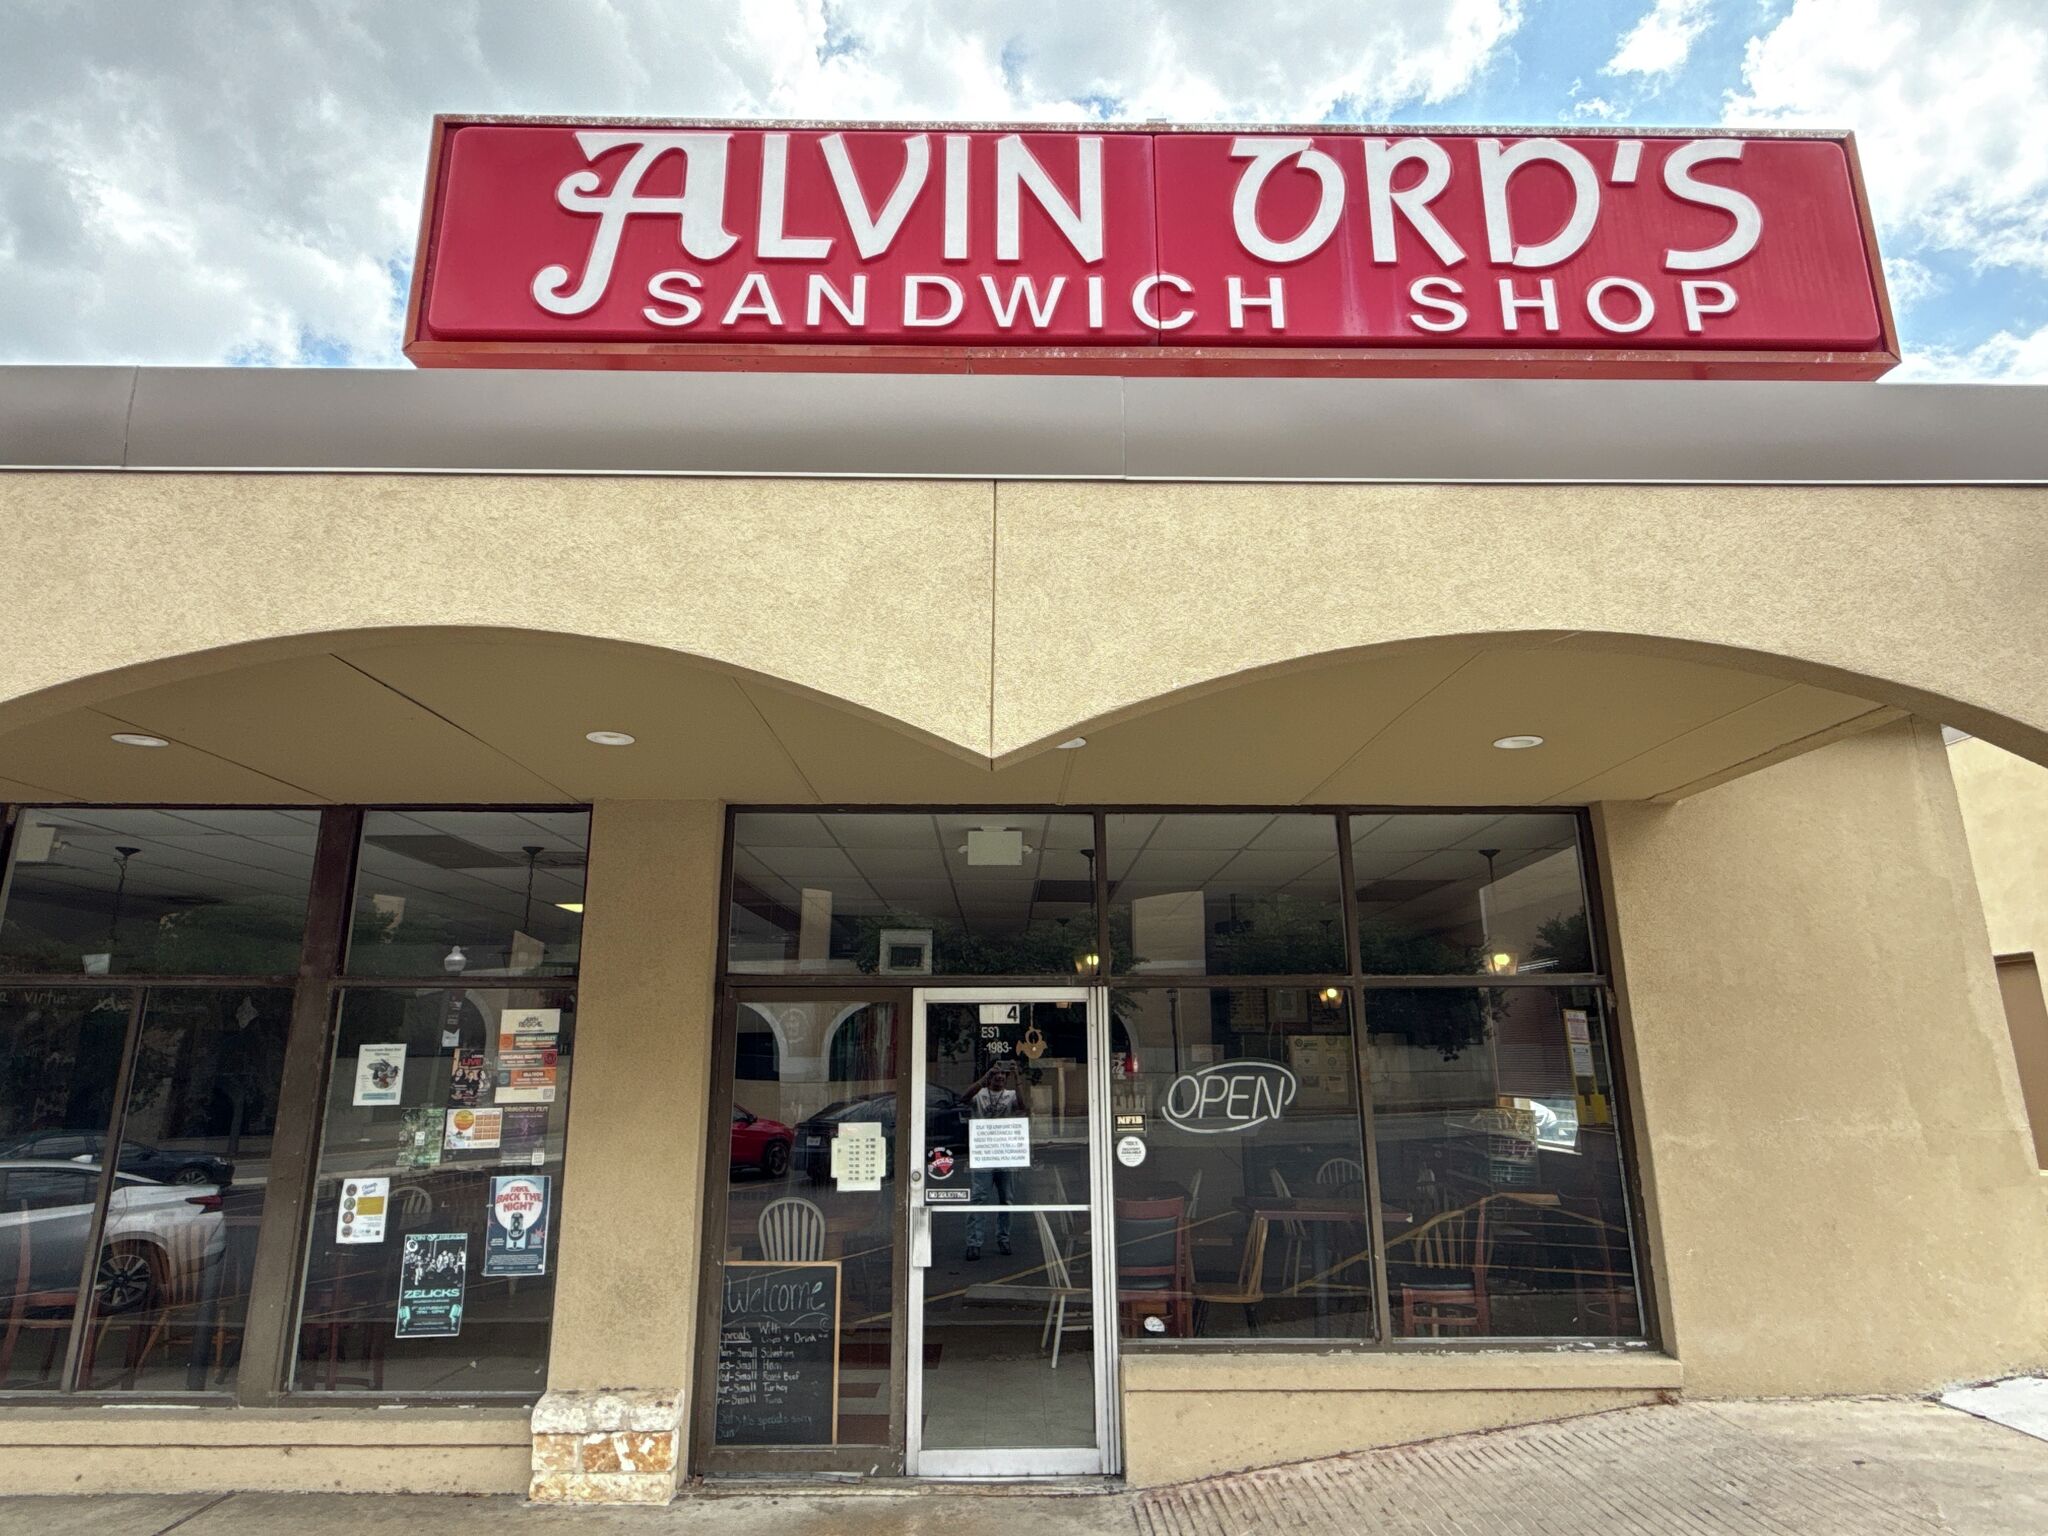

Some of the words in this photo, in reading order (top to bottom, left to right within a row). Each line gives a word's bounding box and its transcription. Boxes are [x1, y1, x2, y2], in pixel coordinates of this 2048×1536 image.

[532, 132, 1105, 315] ALVIN
[1229, 137, 1764, 272] ORD'S
[642, 271, 1287, 330] SANDWICH
[1409, 276, 1739, 333] SHOP
[1006, 1005, 1019, 1022] 4
[1167, 1075, 1286, 1119] OPEN
[1117, 1116, 1143, 1125] NFIB
[496, 1193, 521, 1204] BACK
[522, 1192, 543, 1202] THE
[928, 1191, 938, 1199] NO
[503, 1202, 535, 1213] NIGHT
[403, 1288, 461, 1299] ZELICKS
[726, 1274, 826, 1313] Welcome
[737, 1346, 758, 1358] Small
[735, 1359, 757, 1370] Small
[734, 1371, 757, 1382] Small
[783, 1371, 801, 1381] Beef
[733, 1382, 757, 1393] Small
[762, 1381, 788, 1393] Turkey
[731, 1394, 756, 1405] Small
